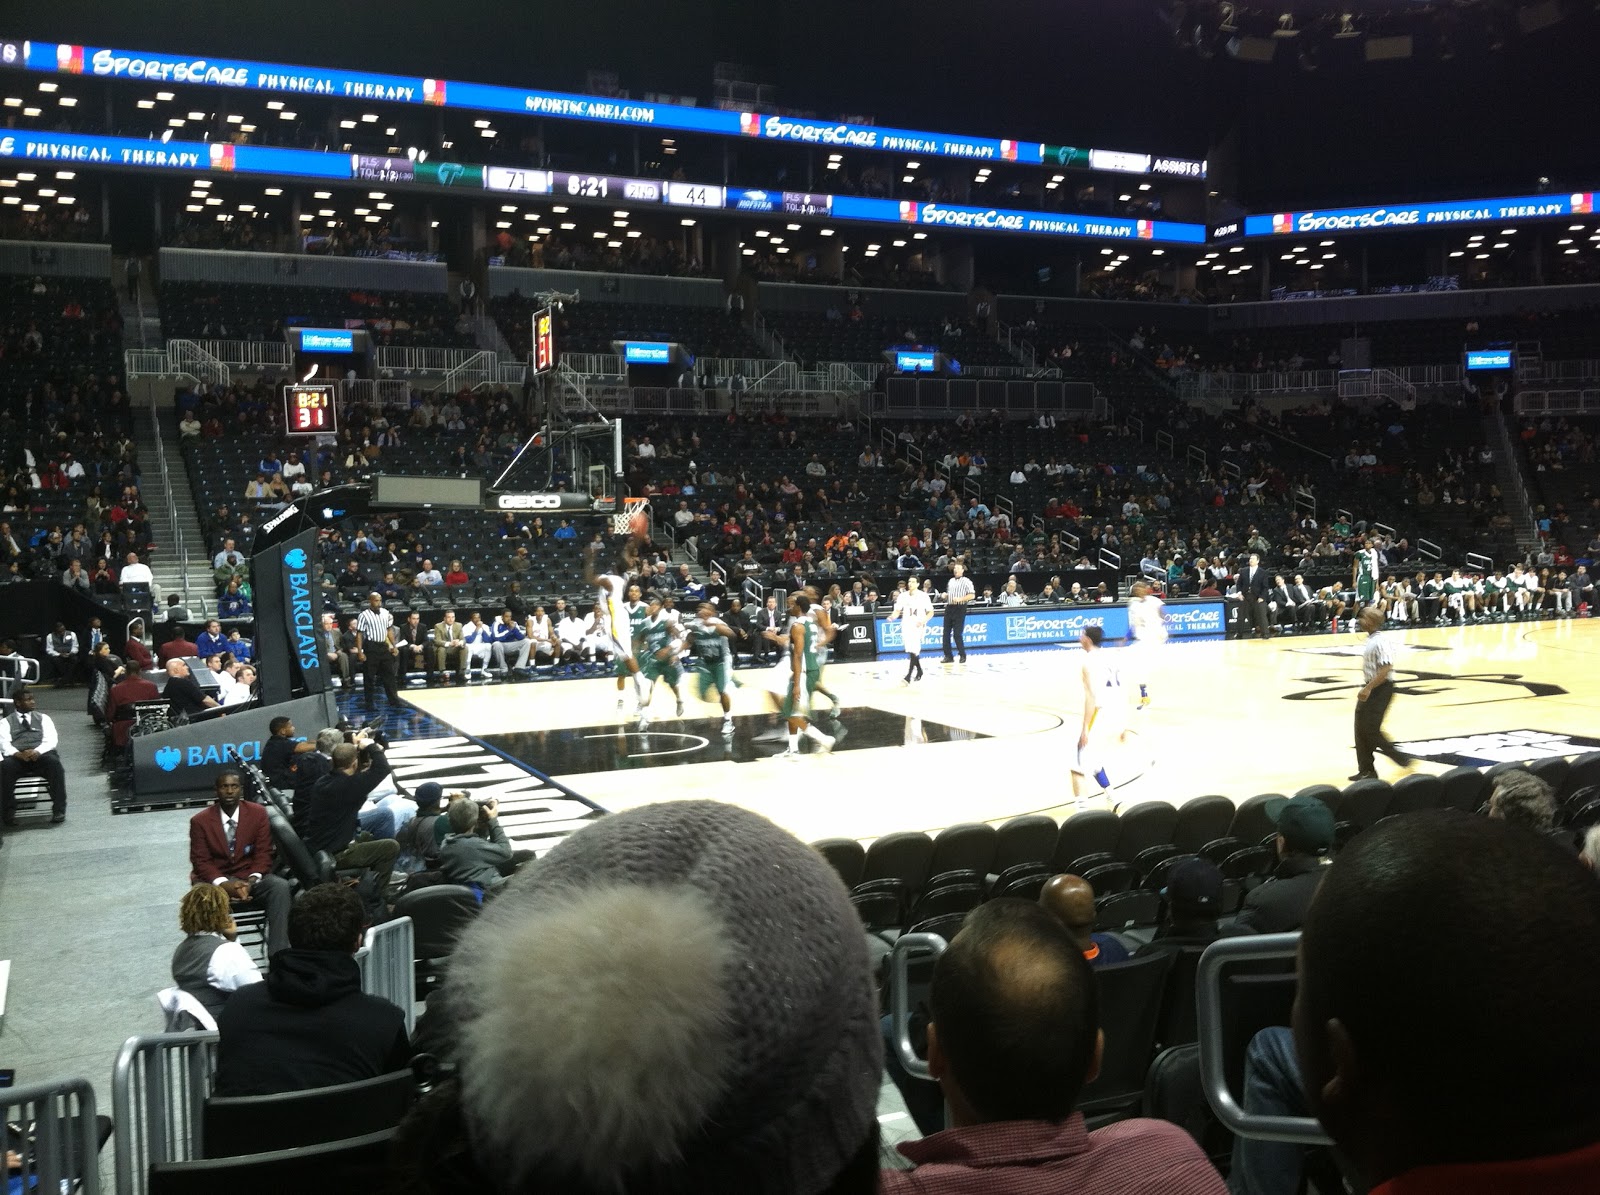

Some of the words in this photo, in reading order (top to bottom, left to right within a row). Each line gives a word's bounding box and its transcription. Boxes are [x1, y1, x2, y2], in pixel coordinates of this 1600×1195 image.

[258, 73, 335, 93] PHYSICAL
[343, 81, 415, 101] THERAPY
[26, 142, 111, 162] PHYSICAL
[121, 148, 199, 167] THERAPY
[882, 136, 938, 153] PHYSICAL
[944, 142, 995, 158] THERAPY
[1153, 158, 1200, 176] ASSISTS
[506, 172, 528, 192] 71
[568, 176, 607, 198] 8:21
[687, 187, 706, 206] 44
[1427, 208, 1493, 222] PHYSICAL
[1500, 204, 1563, 218] THERAPY
[1029, 220, 1080, 233] PHYSICAL
[1085, 223, 1132, 238] THERAPY
[298, 392, 328, 409] 8:21
[299, 408, 323, 428] 31
[498, 495, 561, 509] GEICO
[263, 504, 299, 534] SPALDING
[288, 572, 320, 670] BARCLAYS
[1164, 609, 1220, 623] ORTSCARE
[1027, 629, 1065, 639] PHYSICAL
[1187, 621, 1220, 631] THERAPY
